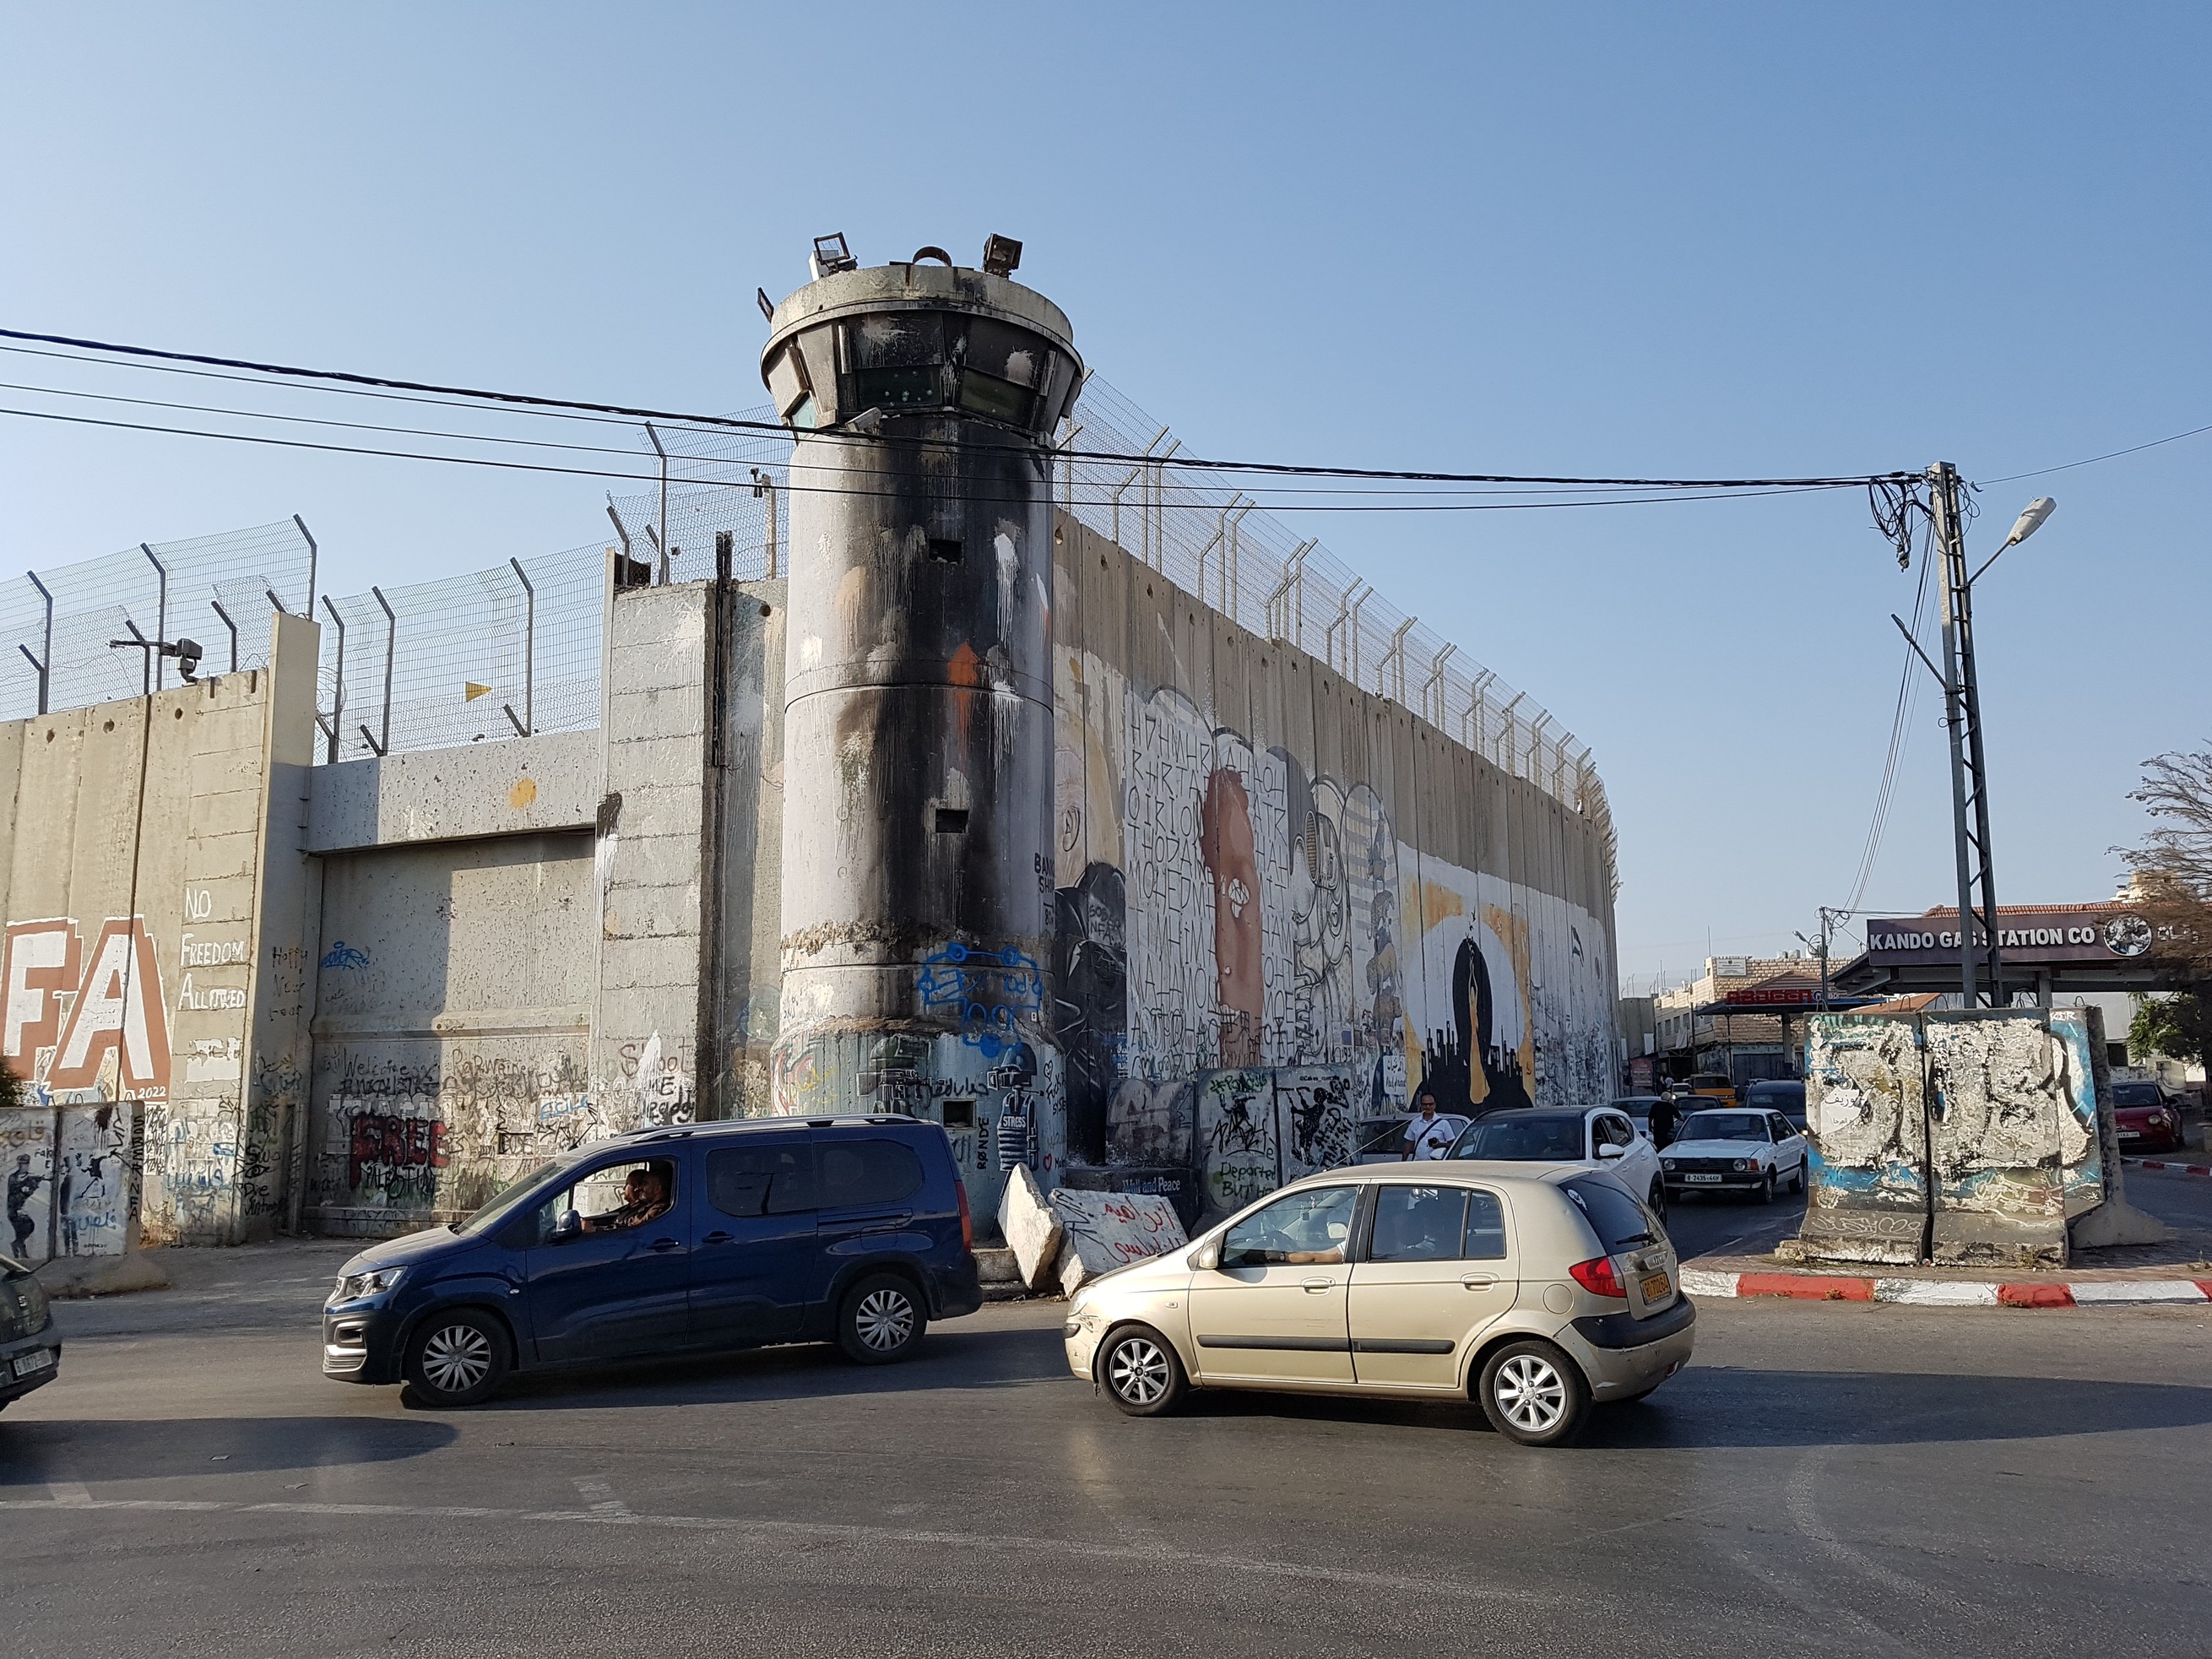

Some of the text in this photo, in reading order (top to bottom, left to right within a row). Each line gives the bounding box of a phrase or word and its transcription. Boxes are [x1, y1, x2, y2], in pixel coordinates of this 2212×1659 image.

[185, 887, 211, 920] NO
[180, 932, 246, 967] FREEDOM
[1870, 932, 1935, 951] KANDO
[2068, 927, 2095, 944] CO
[178, 972, 247, 1011] ALLOWED
[138, 1086, 166, 1099] 2022
[1002, 1115, 1027, 1128] STRESS
[350, 1112, 451, 1190] FREE
[1158, 1176, 1181, 1192] Peace
